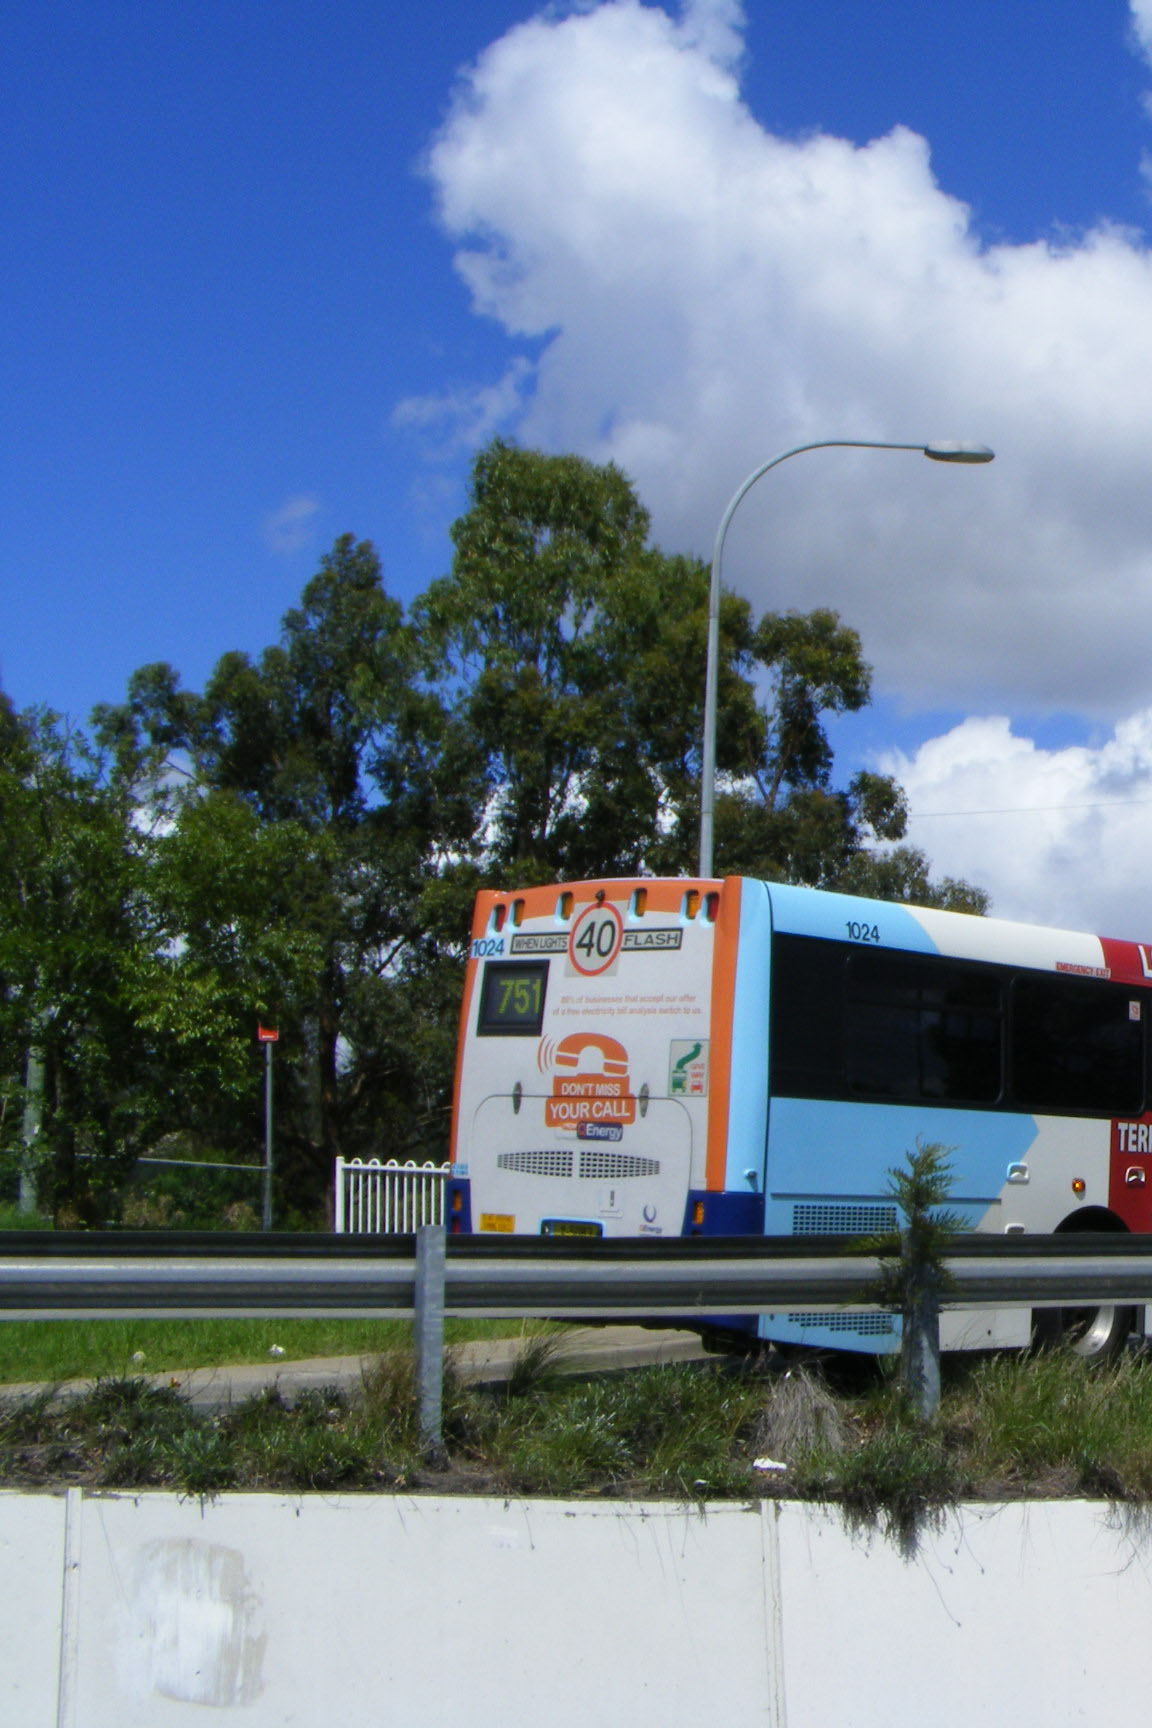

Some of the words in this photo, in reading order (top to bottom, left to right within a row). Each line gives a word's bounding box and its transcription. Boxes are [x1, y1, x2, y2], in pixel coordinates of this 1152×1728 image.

[575, 919, 617, 958] 40
[624, 933, 679, 946] FLASH
[846, 921, 881, 942] 1024
[472, 938, 505, 957] 1024
[515, 938, 539, 949] WHEN
[540, 936, 568, 949] LIGHTS
[1056, 961, 1094, 976] EMERGENCY
[498, 979, 542, 1014] 751
[561, 1083, 594, 1096] DON'T
[595, 1083, 621, 1096] MISS
[550, 1103, 589, 1119] YOUR
[592, 1101, 631, 1118] CALL
